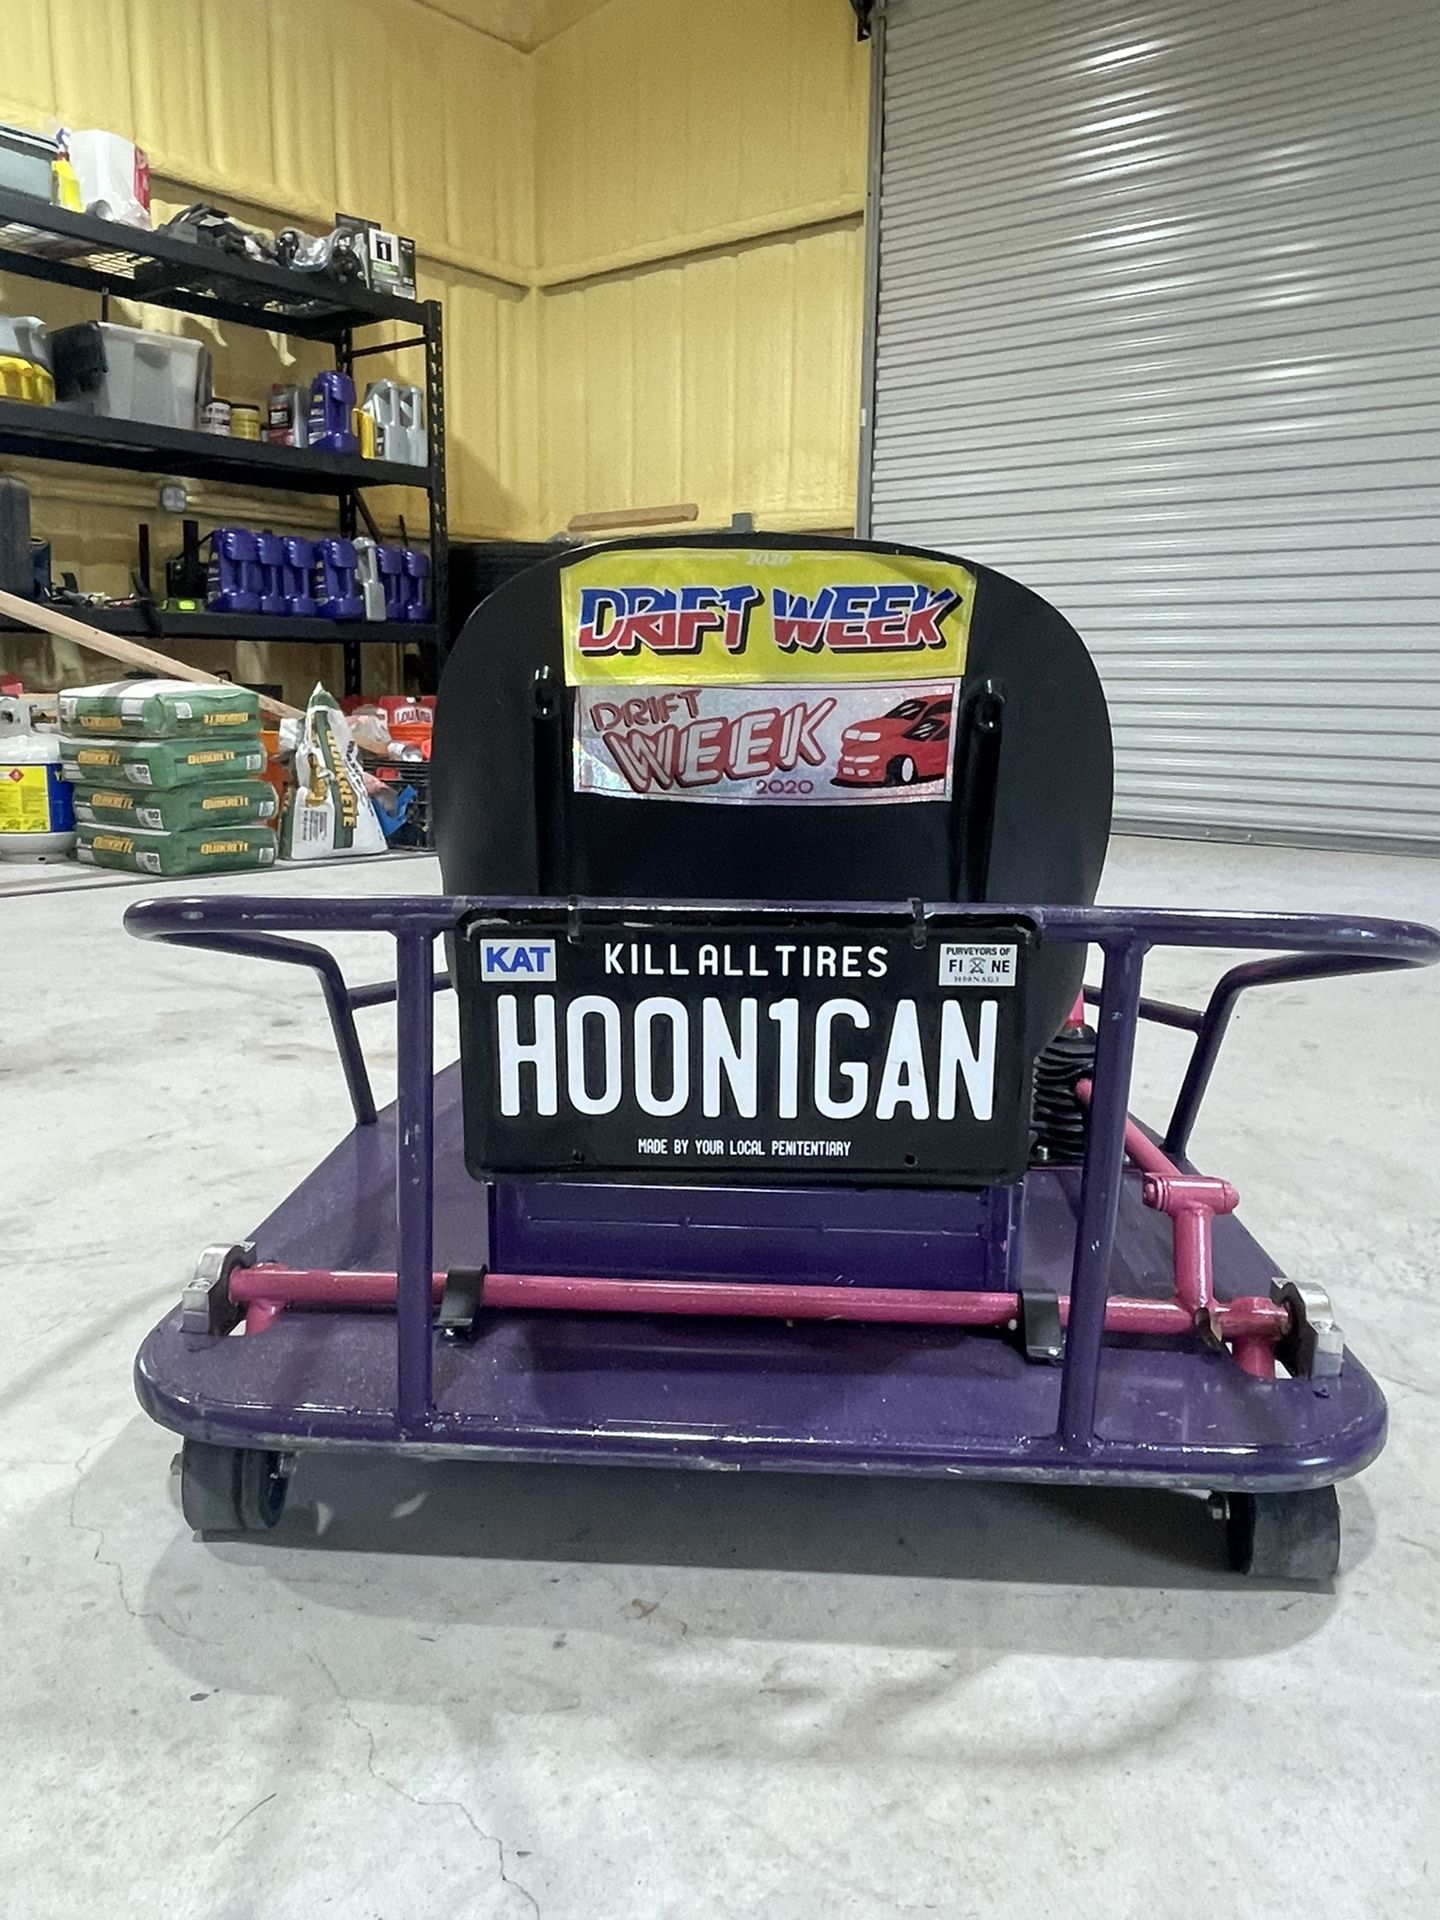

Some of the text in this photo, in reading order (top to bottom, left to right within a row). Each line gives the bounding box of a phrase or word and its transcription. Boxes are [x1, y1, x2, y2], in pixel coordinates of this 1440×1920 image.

[746, 552, 793, 567] 2020
[578, 584, 963, 656] DRIFT WEEK
[589, 689, 702, 731] DRIFT
[602, 697, 838, 793] WEEK
[187, 751, 236, 765] QUIKRETE
[327, 730, 357, 829] QUIKRETE
[756, 779, 814, 794] 2020
[202, 796, 249, 810] QUIKRETE
[201, 840, 248, 854] QUIKRETE
[486, 947, 550, 972] KAT
[605, 943, 888, 977] KILL ALL TIRES
[946, 947, 1011, 956] PURVEYORS OF
[497, 994, 998, 1121] HOON1GAN
[638, 1138, 852, 1157] MADE BY YOUR LOCAL PENITENTIARY
